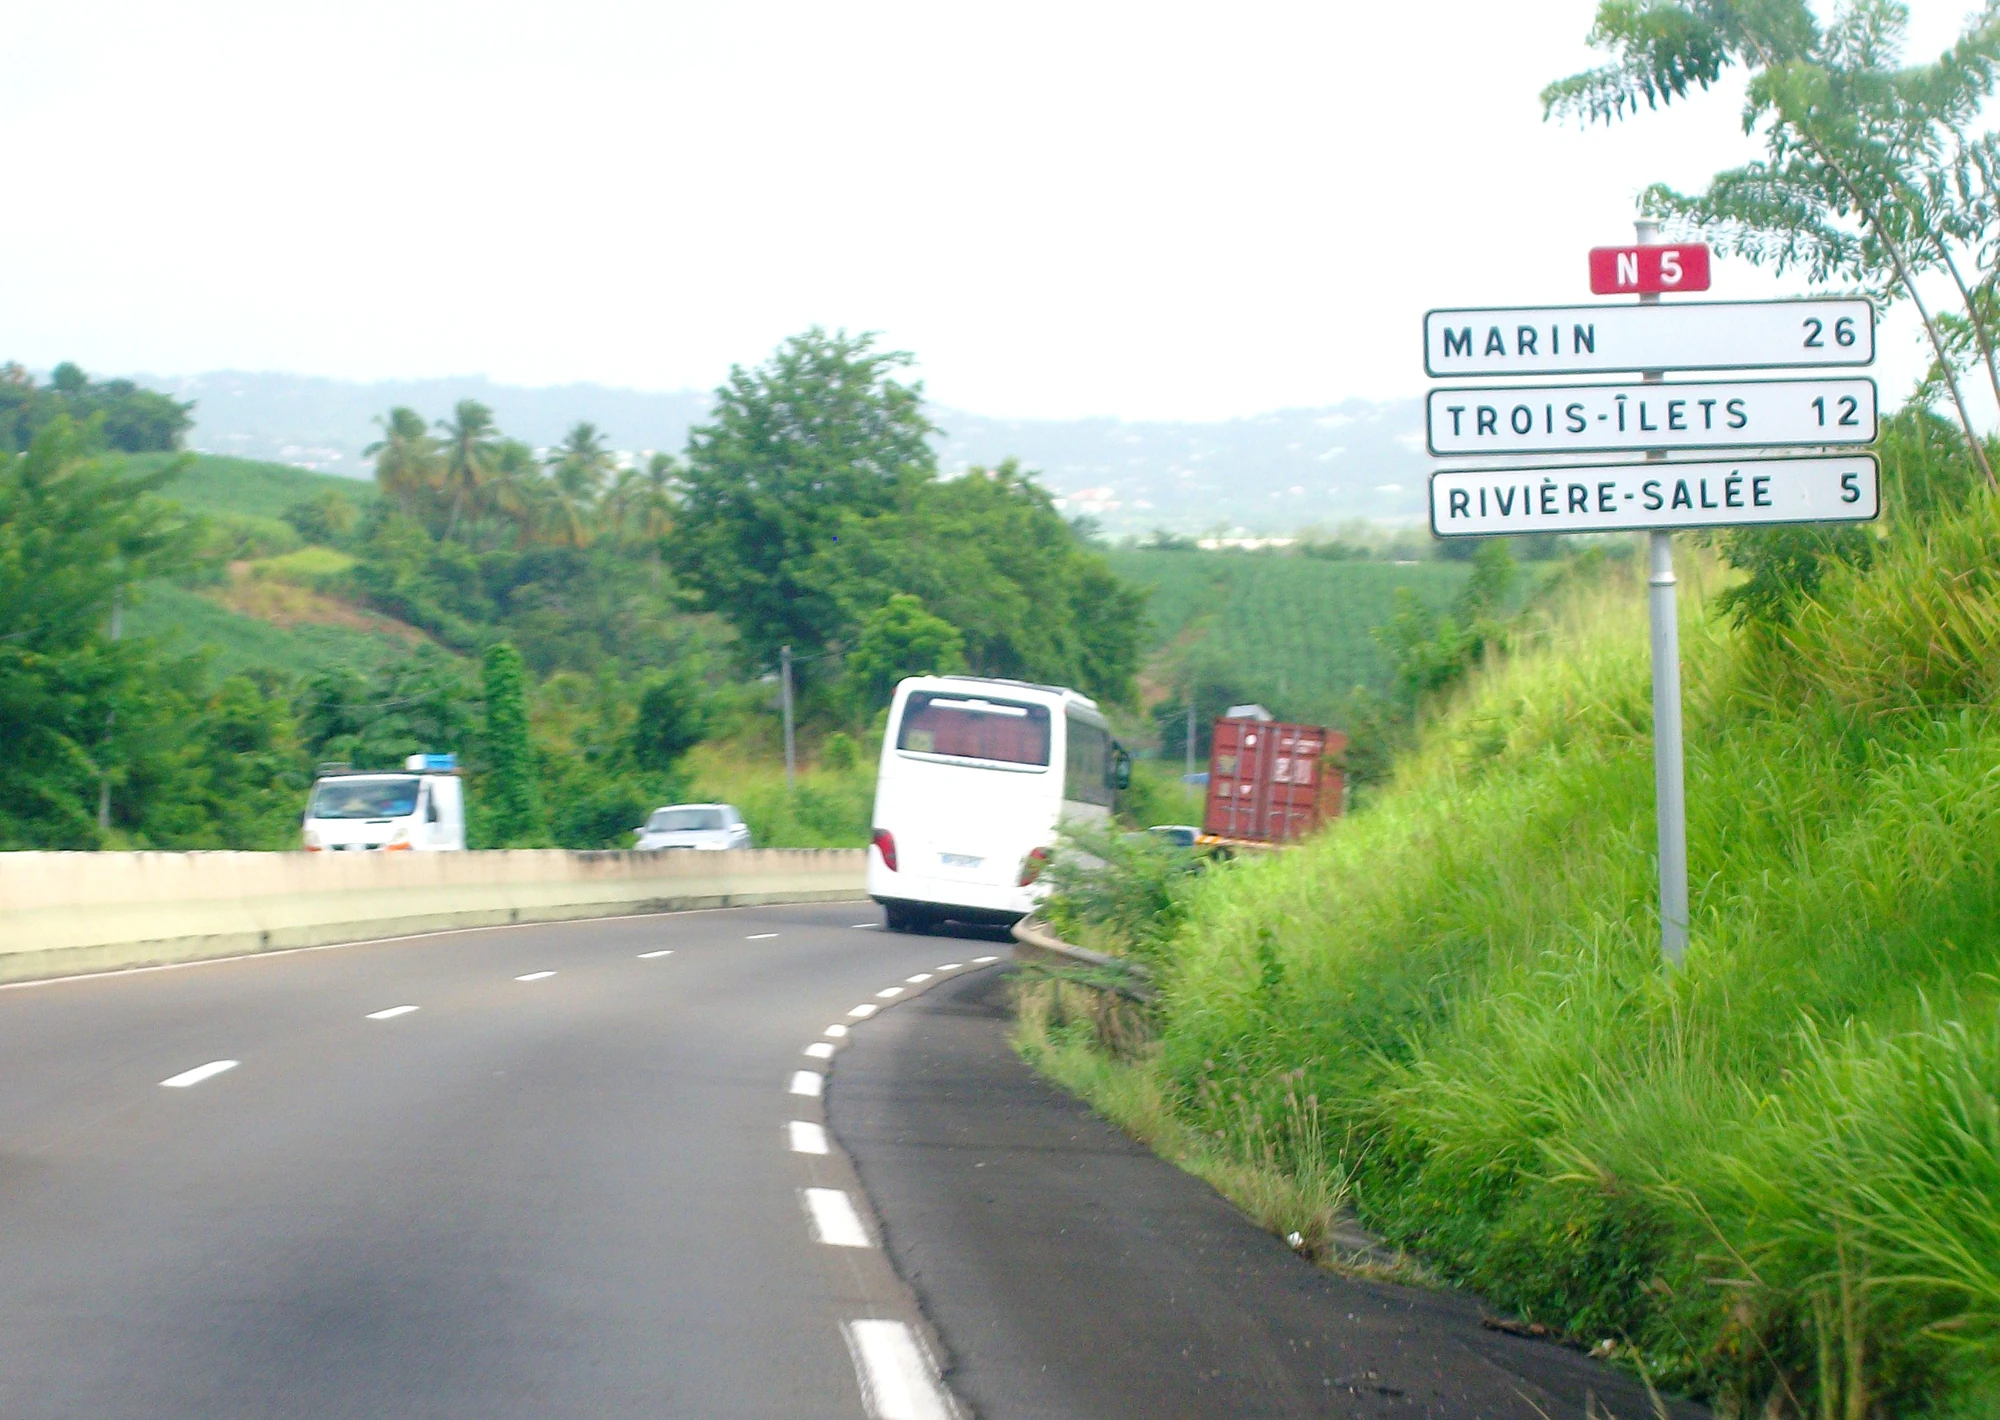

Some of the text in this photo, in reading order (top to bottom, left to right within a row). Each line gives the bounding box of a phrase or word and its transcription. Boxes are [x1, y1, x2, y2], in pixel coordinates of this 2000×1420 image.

[1616, 251, 1683, 286] N 5
[1443, 317, 1856, 357] MARIN 26
[1446, 394, 1859, 436] TROIS-ÎLETS 12
[1449, 470, 1861, 518] RIVIÈRE-SALÉE 5
